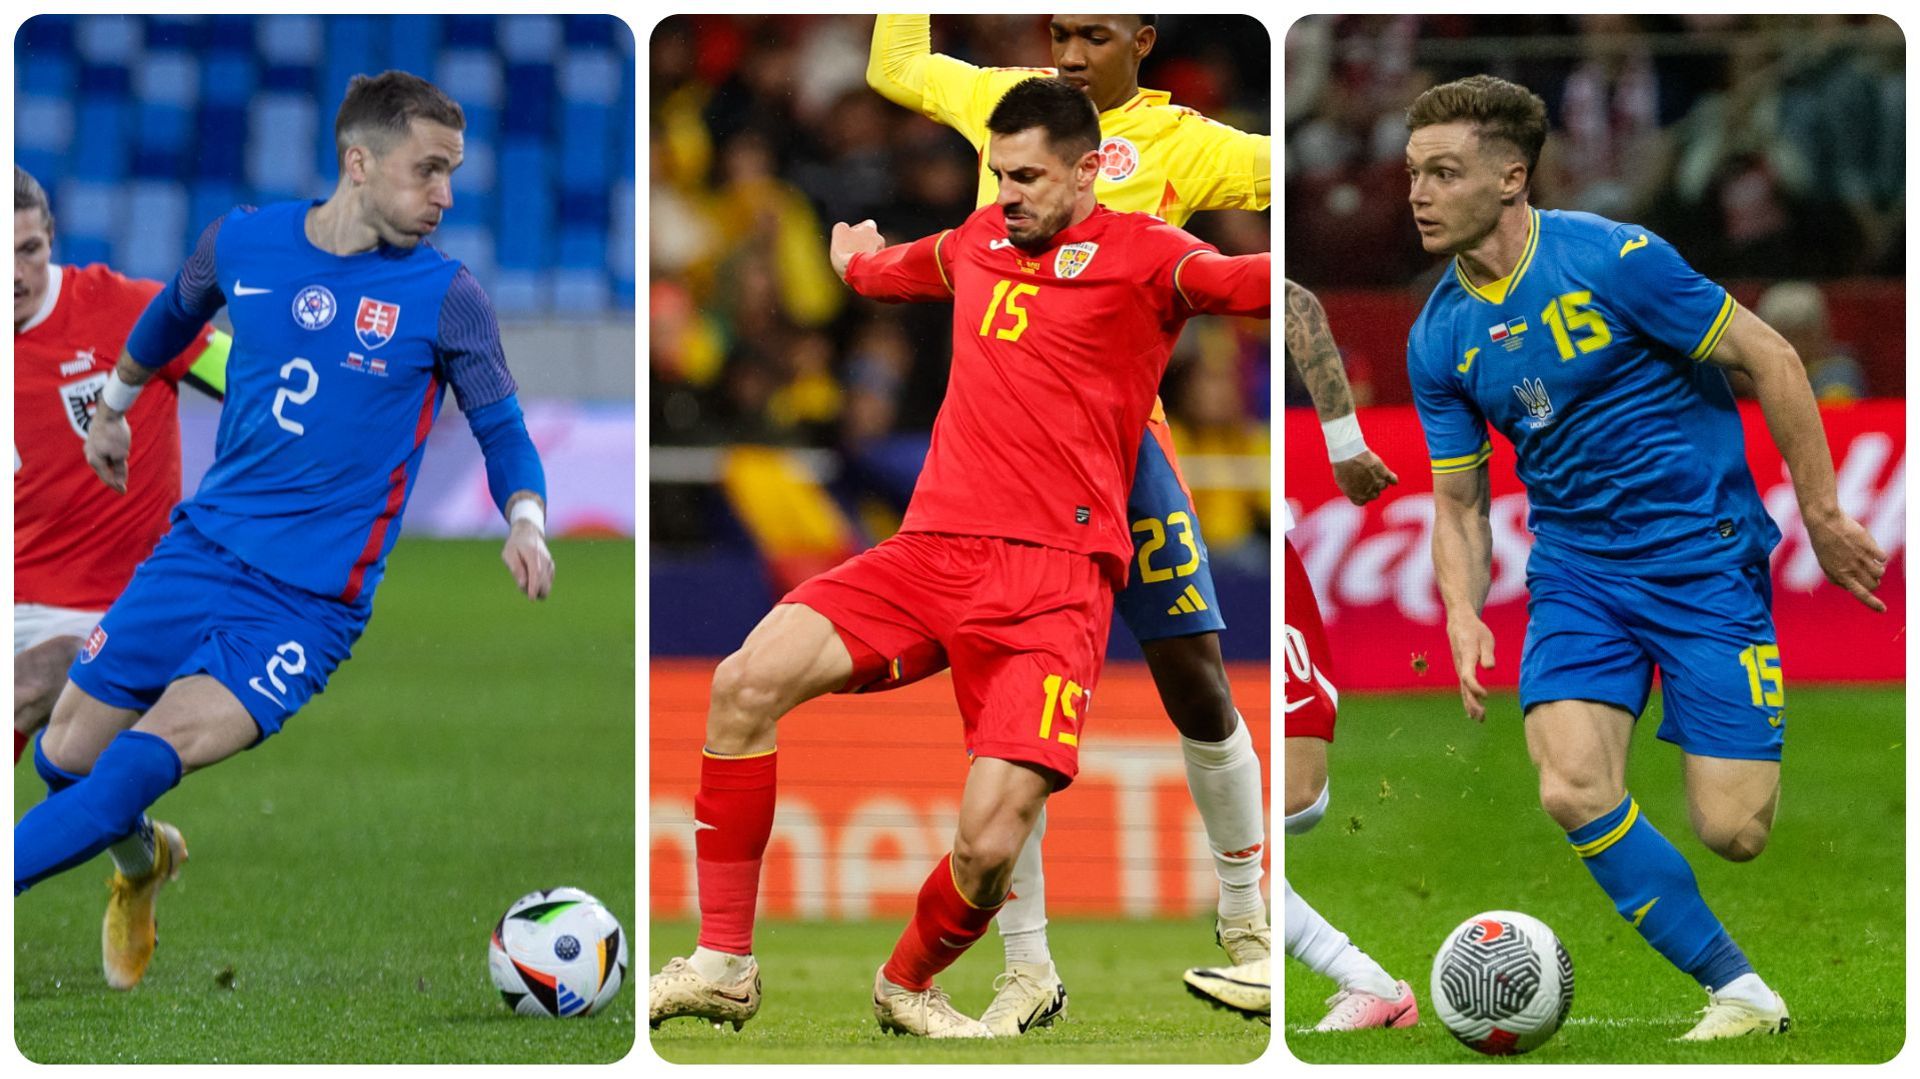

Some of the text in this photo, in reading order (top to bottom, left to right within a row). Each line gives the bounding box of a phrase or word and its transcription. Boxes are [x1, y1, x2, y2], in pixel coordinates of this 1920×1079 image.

[979, 279, 1040, 342] 15
[1541, 289, 1613, 361] 15
[272, 357, 319, 436] 2
[1132, 511, 1199, 583] 23
[266, 641, 306, 695] 2
[1739, 645, 1784, 708] 15
[1038, 674, 1083, 748] 15
